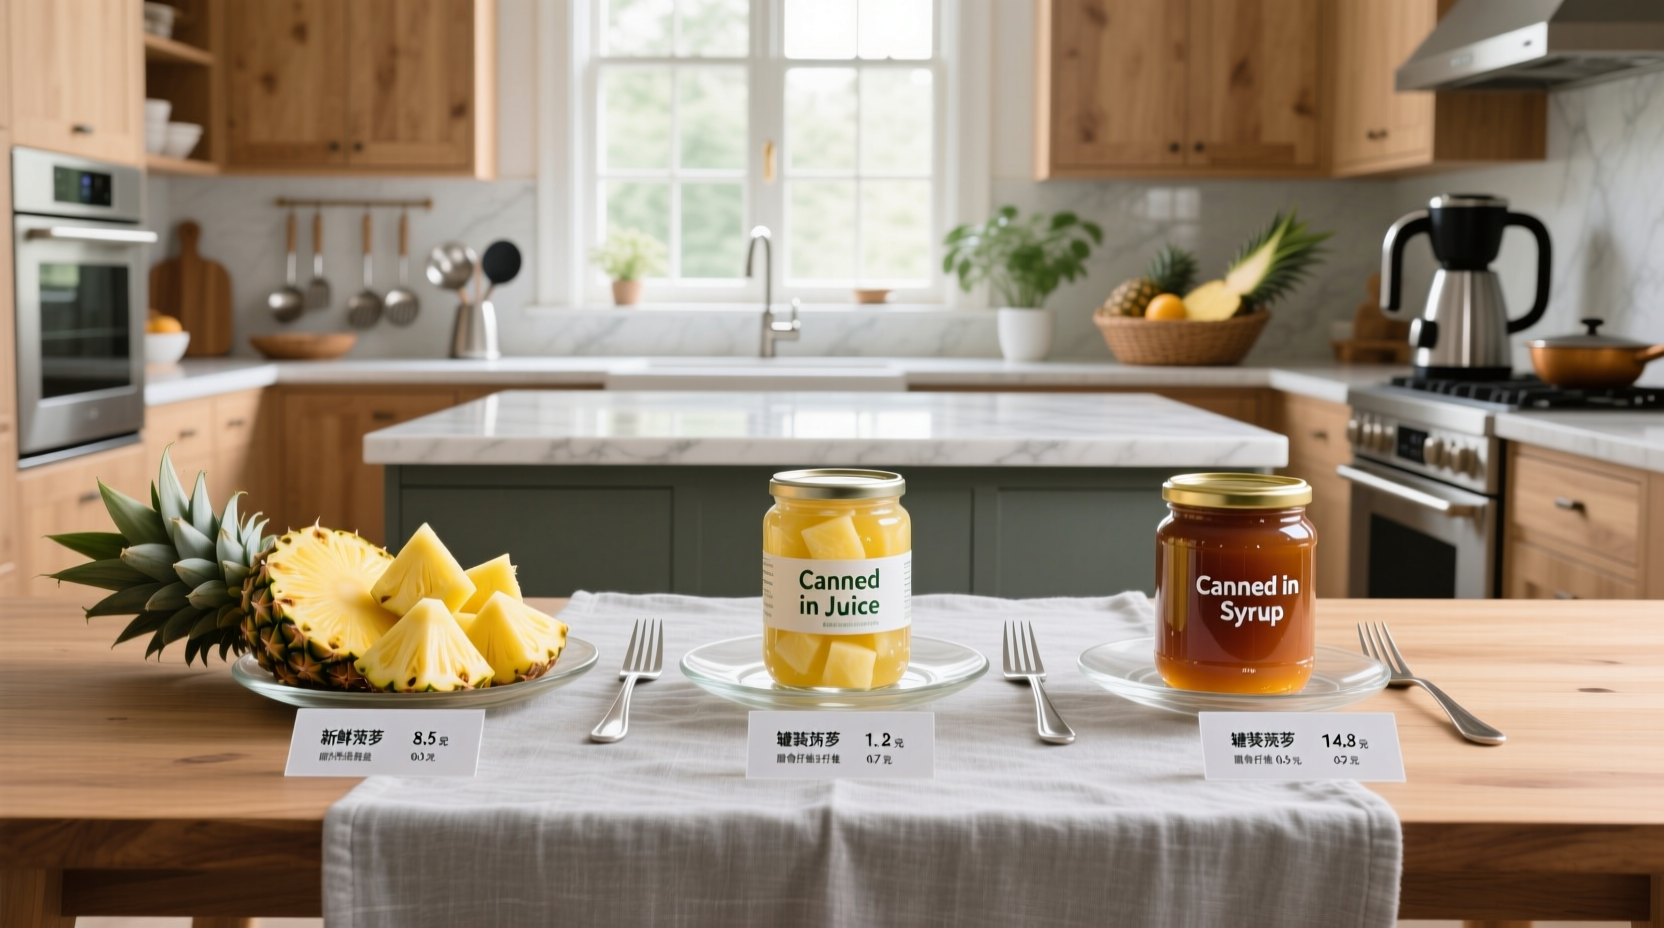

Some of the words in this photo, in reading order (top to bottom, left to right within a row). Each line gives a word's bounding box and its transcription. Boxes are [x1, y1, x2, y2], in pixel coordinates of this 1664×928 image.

[799, 568, 880, 590] Canned
[1196, 575, 1277, 596] Canned
[1282, 575, 1299, 595] in
[800, 594, 819, 615] in
[825, 595, 880, 617] Juice
[1220, 600, 1284, 628] Syrup
[1321, 733, 1357, 748] 14.8
